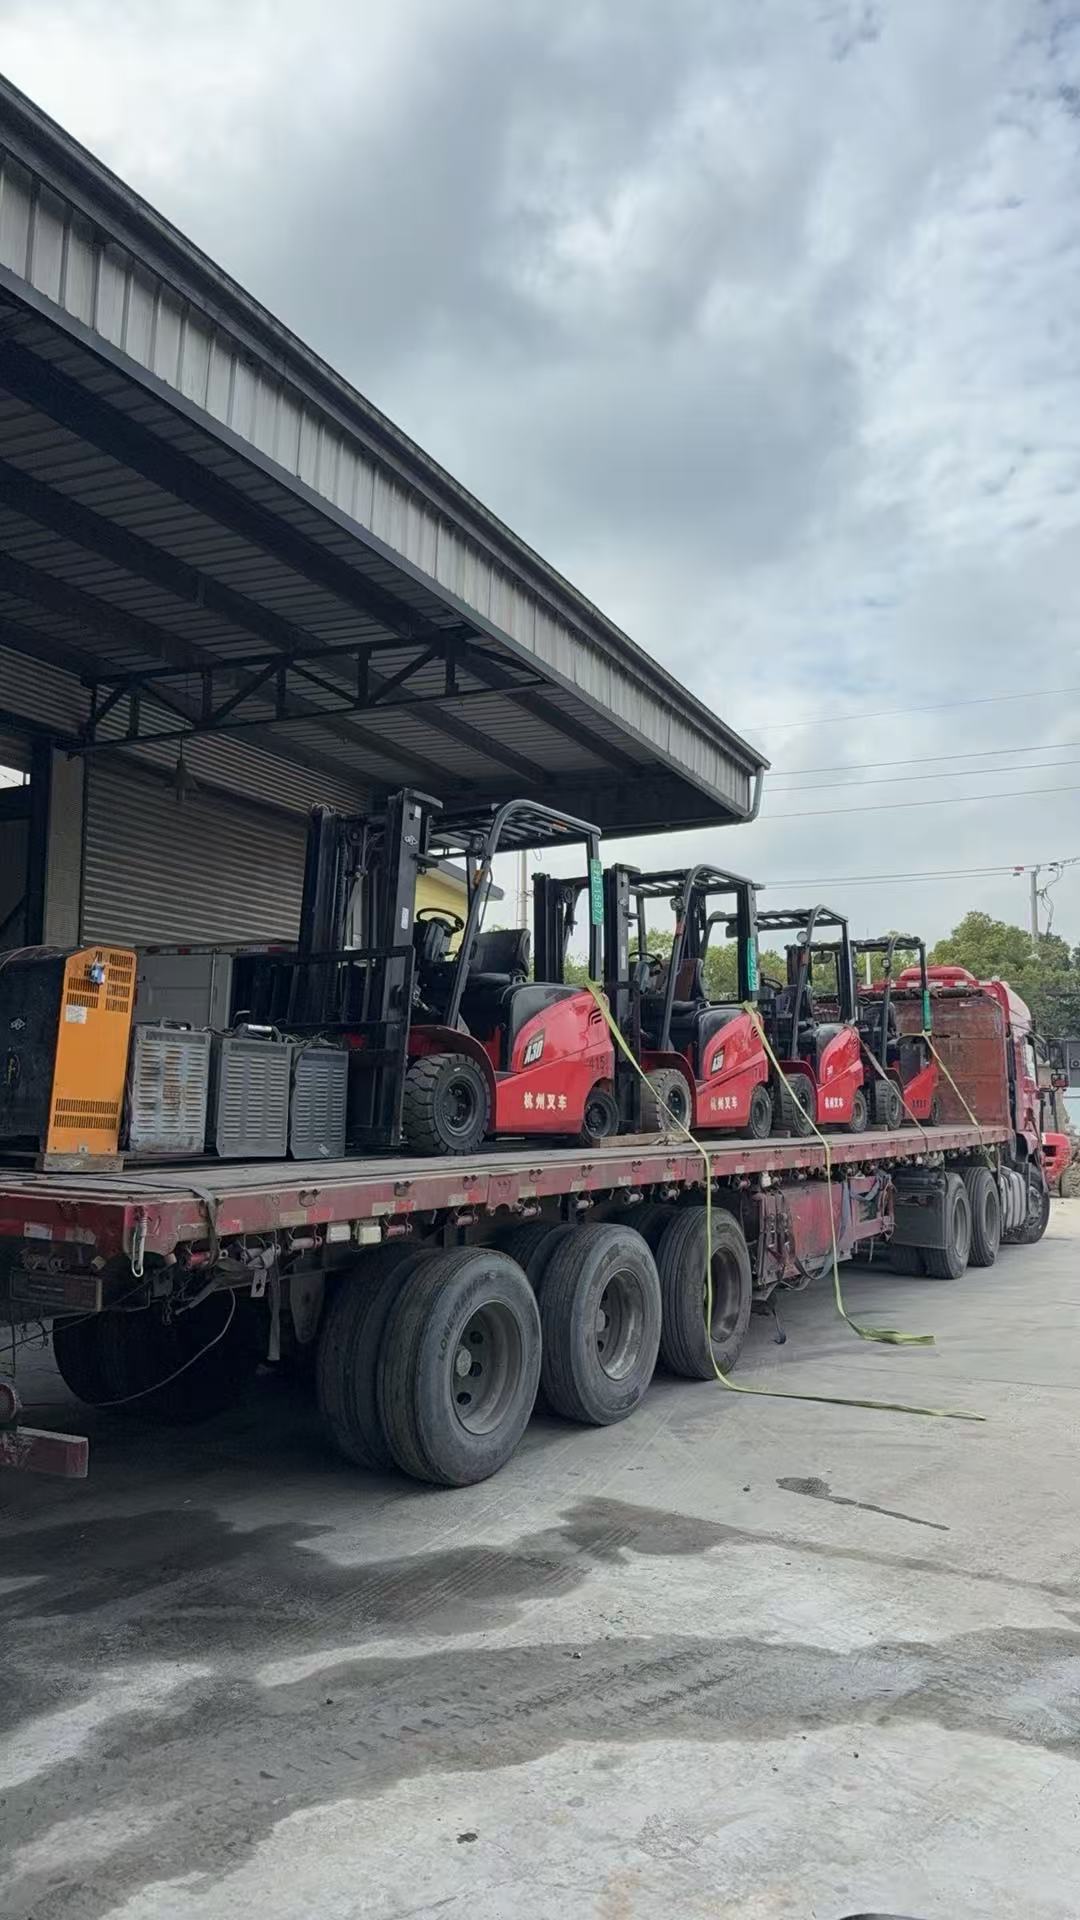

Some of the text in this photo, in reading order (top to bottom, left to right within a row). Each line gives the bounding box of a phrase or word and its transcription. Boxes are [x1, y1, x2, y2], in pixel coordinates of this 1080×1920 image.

[523, 1040, 543, 1065] A30
[523, 1091, 567, 1110] 杭州叉车
